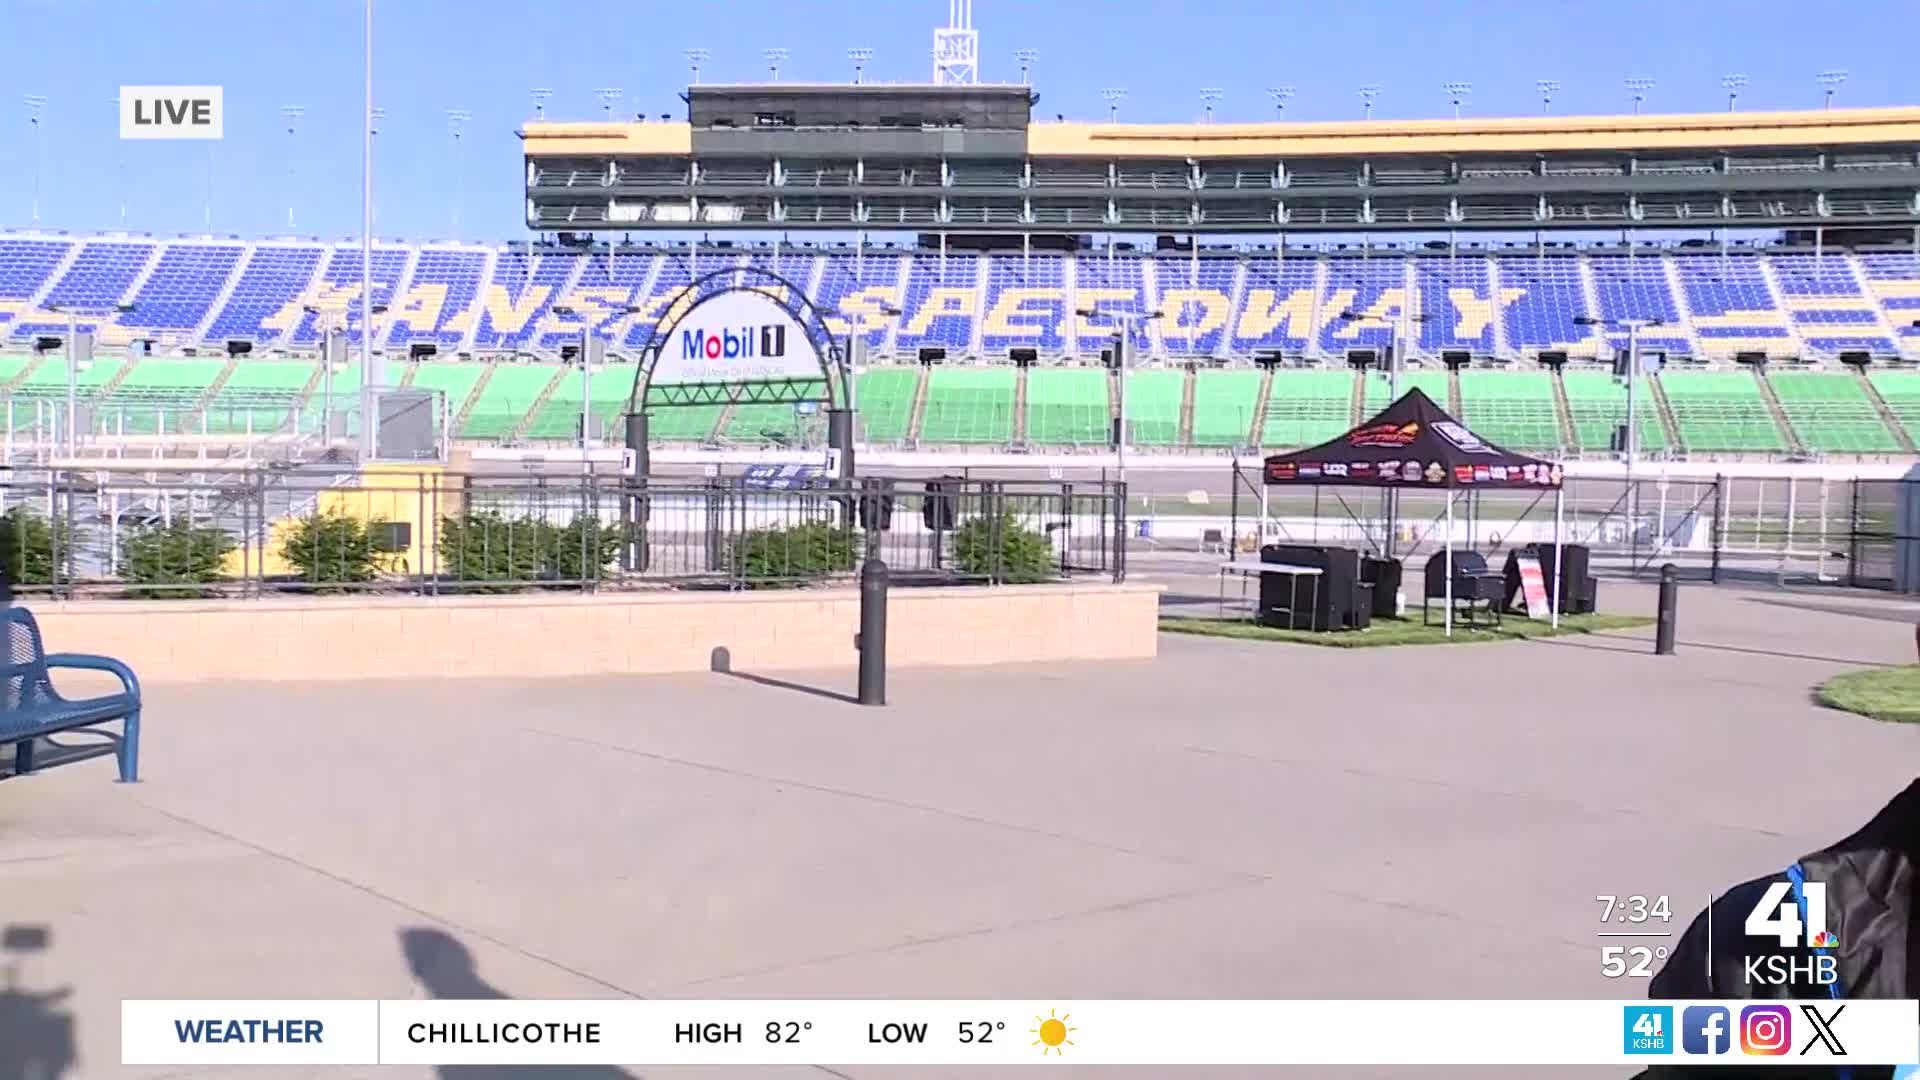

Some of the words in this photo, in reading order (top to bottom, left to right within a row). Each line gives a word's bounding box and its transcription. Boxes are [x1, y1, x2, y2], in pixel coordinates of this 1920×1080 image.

[826, 286, 1528, 339] SPEEDWAY
[682, 326, 754, 360] Mobil
[761, 324, 785, 357] 1
